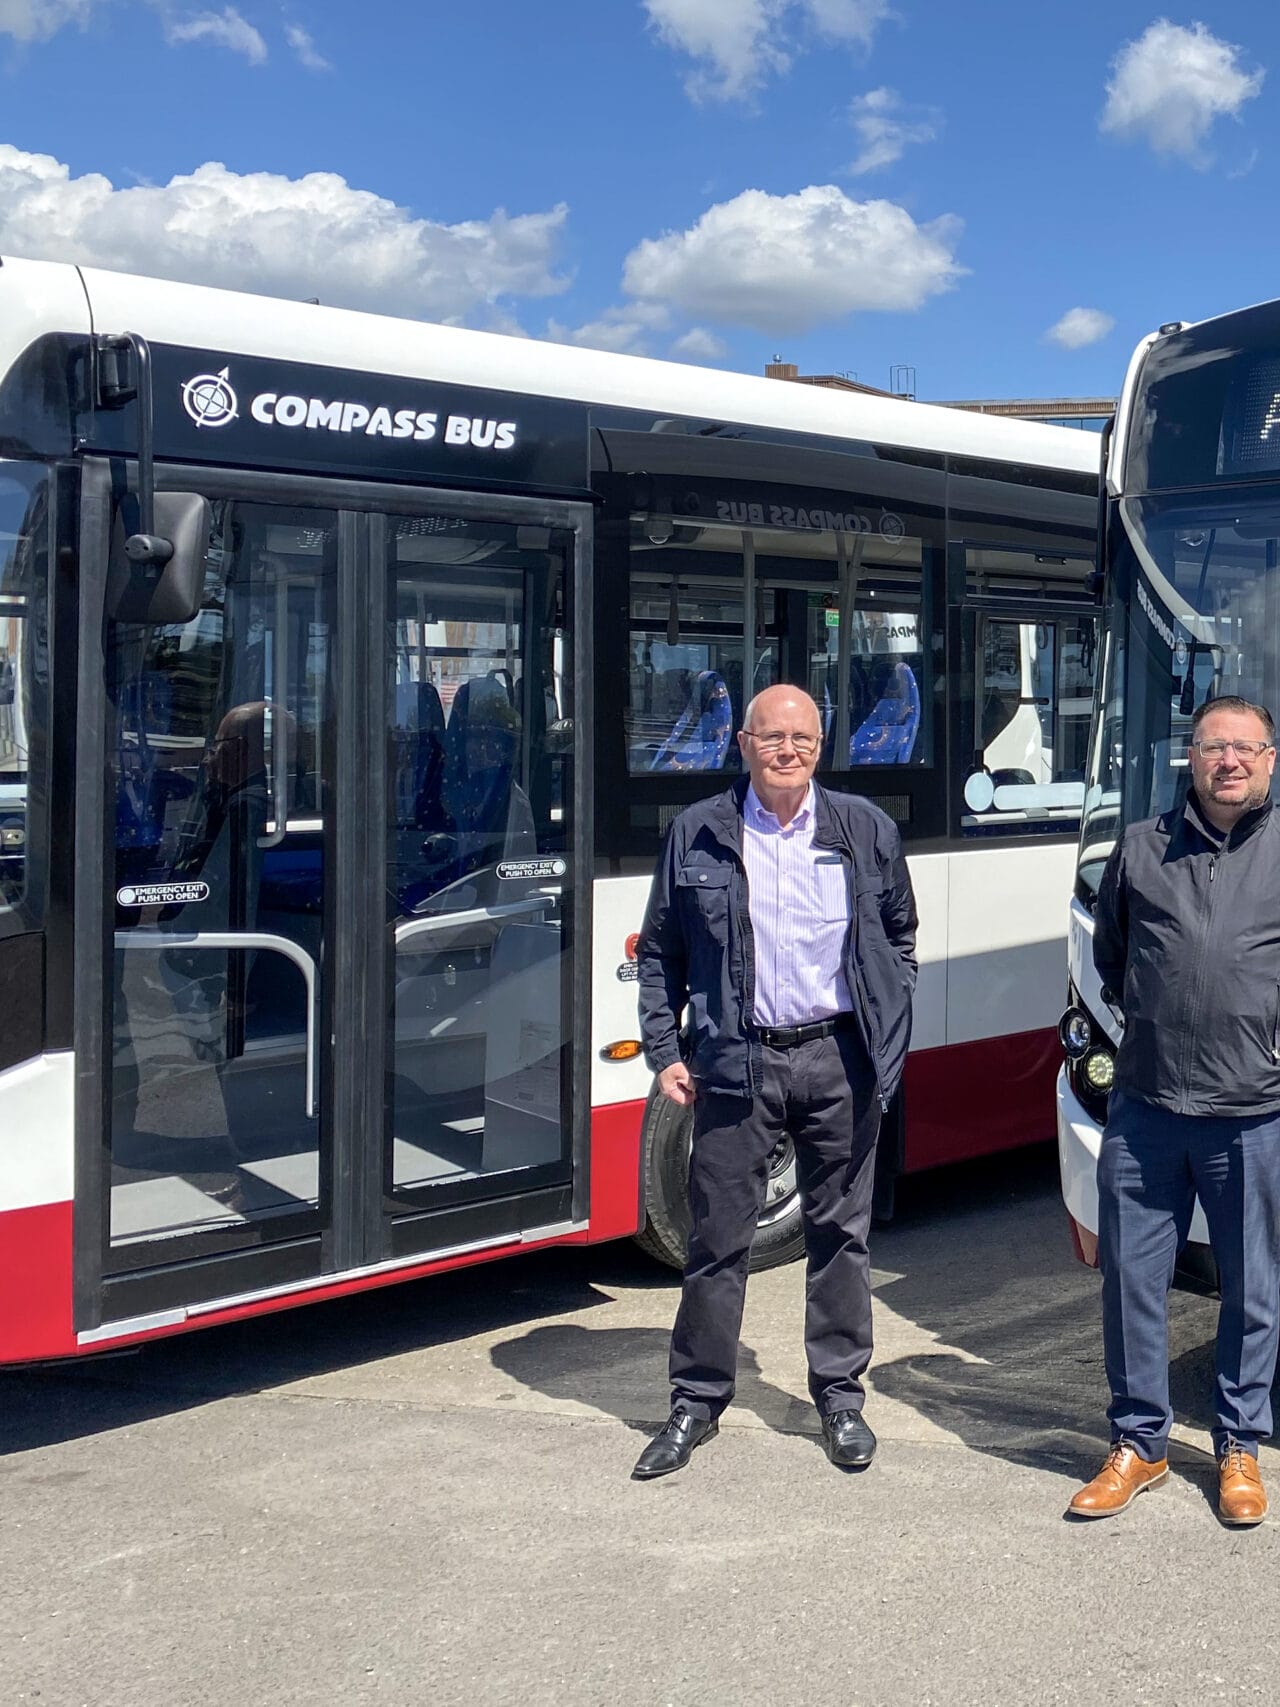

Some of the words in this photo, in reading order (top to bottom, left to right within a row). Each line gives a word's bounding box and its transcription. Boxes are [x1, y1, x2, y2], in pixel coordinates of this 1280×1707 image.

[250, 393, 438, 441] COMPASS
[444, 415, 517, 449] BUS
[501, 862, 539, 871] EMERGENCY
[505, 870, 523, 878] PUSH
[135, 885, 185, 896] EMERGENCY
[186, 884, 204, 892] EXIT
[138, 895, 160, 903] PUSH
[175, 892, 199, 900] OPEN
